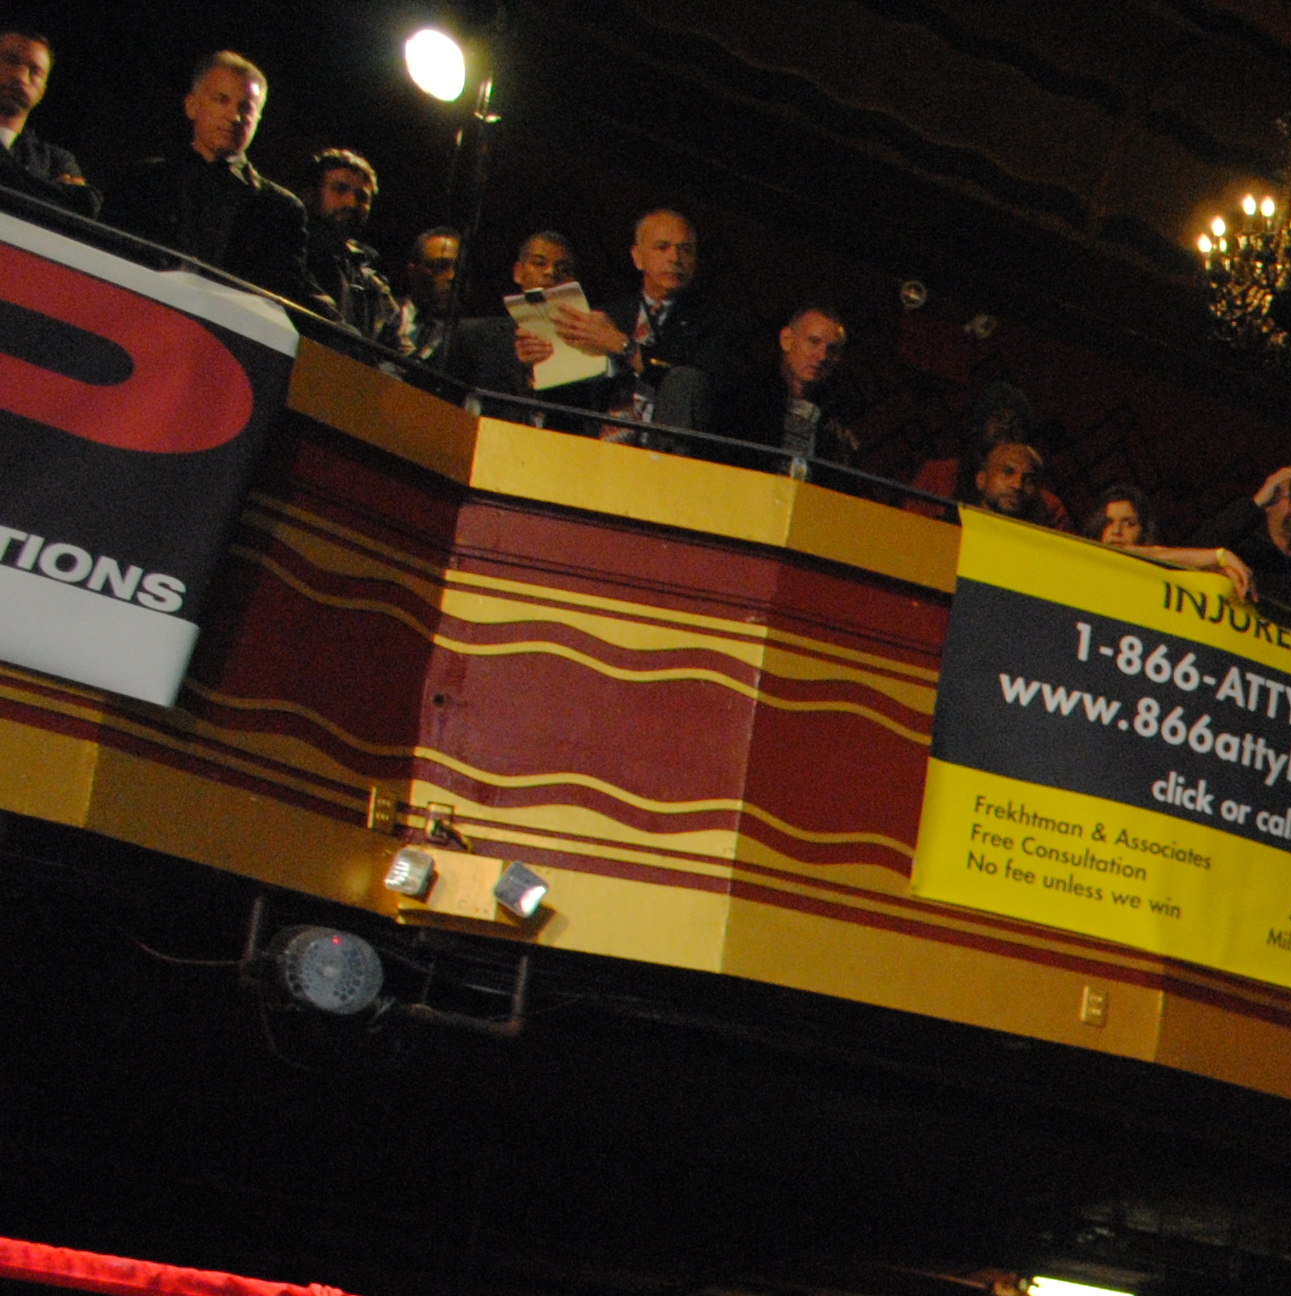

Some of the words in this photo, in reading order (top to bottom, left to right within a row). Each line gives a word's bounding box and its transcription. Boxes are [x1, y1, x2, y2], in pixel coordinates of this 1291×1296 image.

[1152, 771, 1214, 817] click
[1221, 799, 1246, 824] or
[970, 823, 1013, 850] Free
[1021, 836, 1147, 880] Consultation
[974, 795, 1083, 837] Frekhtman
[1091, 822, 1106, 843] &
[1114, 829, 1211, 870] Associates
[967, 851, 998, 875] No
[1005, 858, 1035, 884] fee
[1043, 874, 1103, 900] unless
[1111, 891, 1141, 909] we
[1149, 897, 1181, 919] win
